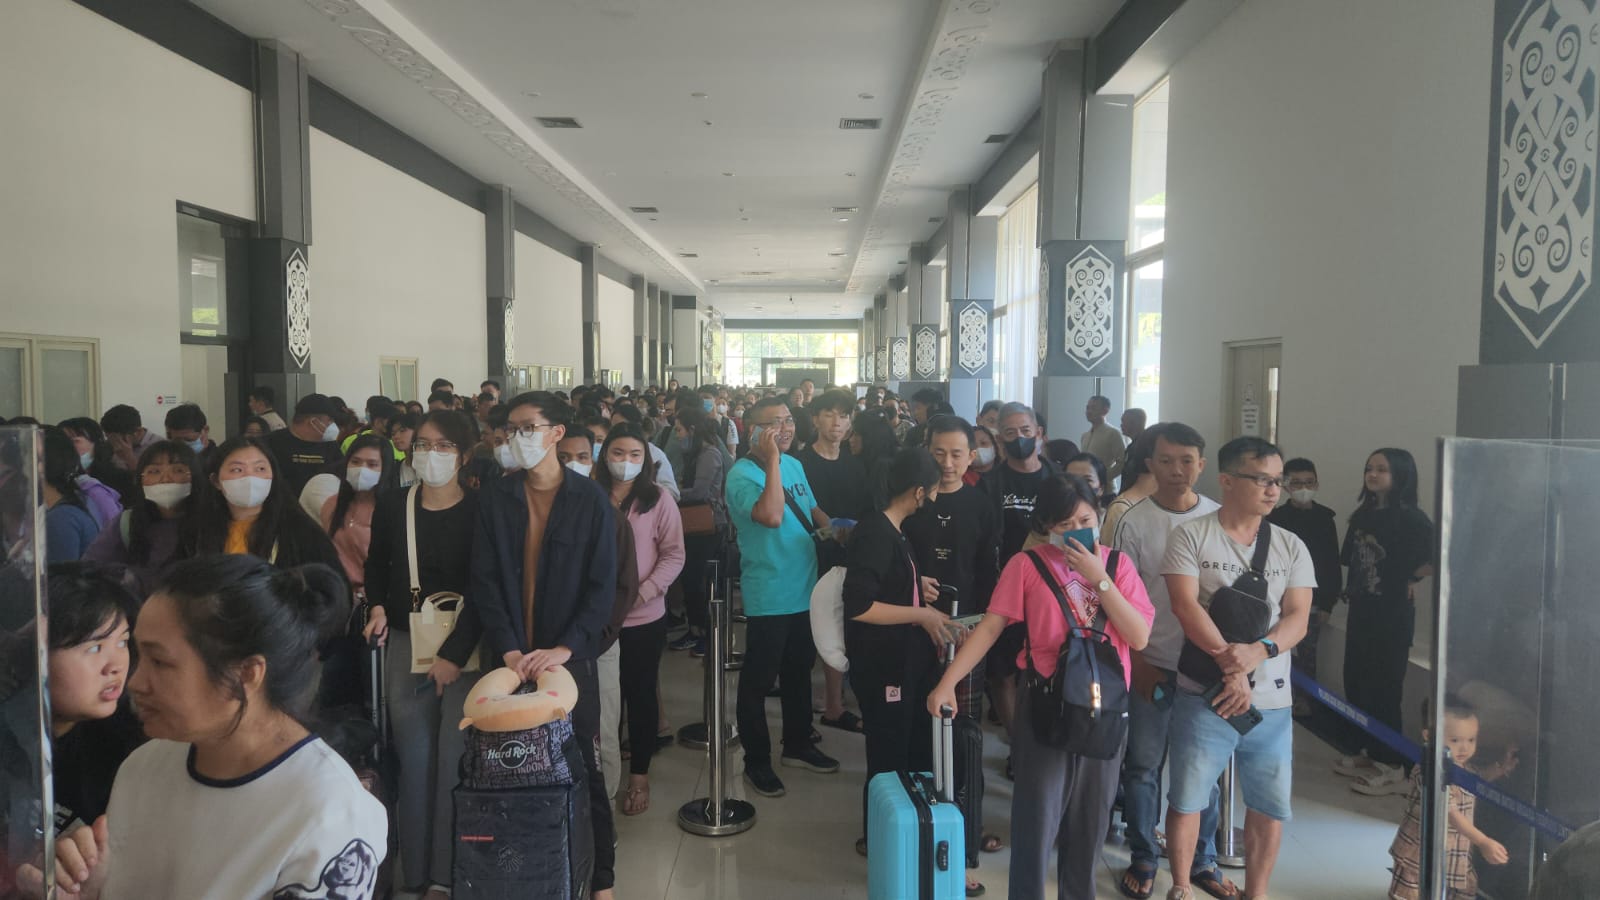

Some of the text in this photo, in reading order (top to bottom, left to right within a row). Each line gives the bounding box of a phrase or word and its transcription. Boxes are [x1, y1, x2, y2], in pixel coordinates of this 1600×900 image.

[1200, 560, 1287, 577] GREENGHT
[487, 747, 512, 760] Hard
[512, 743, 536, 759] Rock
